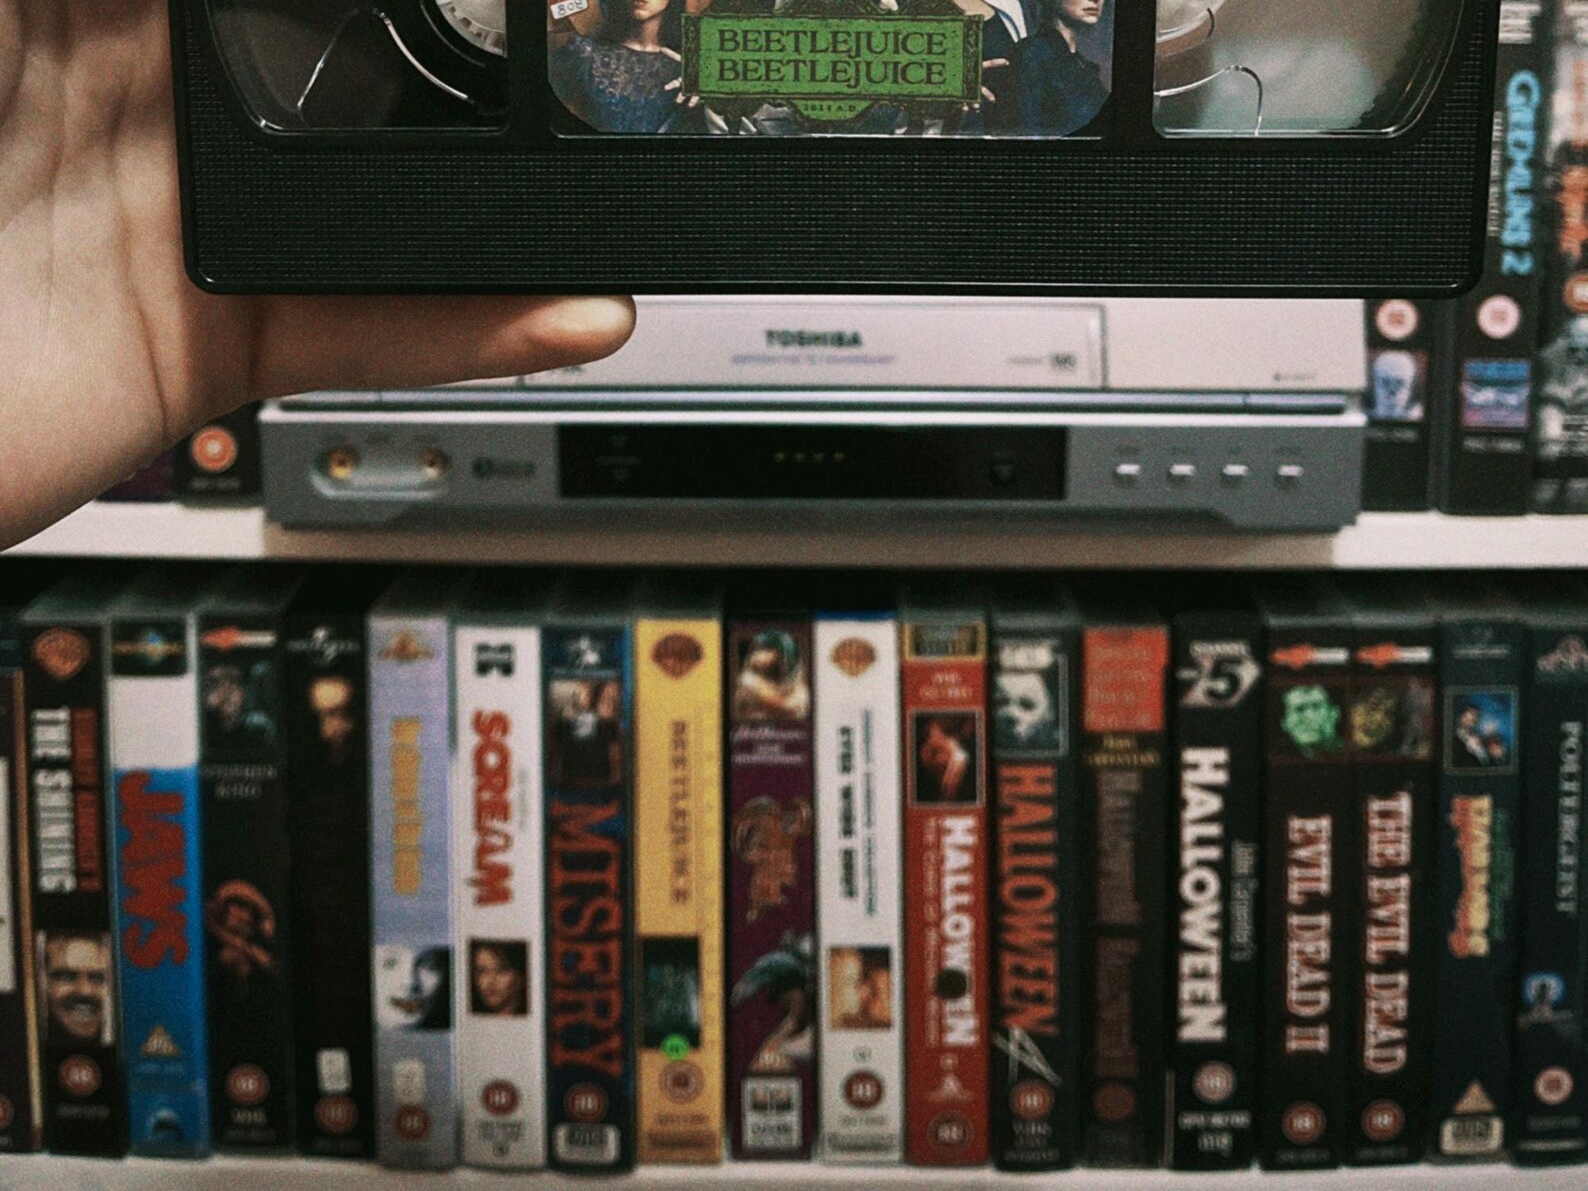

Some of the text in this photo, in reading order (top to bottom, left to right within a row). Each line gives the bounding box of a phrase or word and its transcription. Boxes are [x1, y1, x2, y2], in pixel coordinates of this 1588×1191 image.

[717, 29, 948, 59] BEETLEJUICE
[717, 59, 947, 89] BEETLEJUICE
[765, 329, 863, 347] TOSHIBA
[1501, 251, 1535, 276] 2
[32, 708, 77, 893] THE SHINING
[117, 771, 189, 969] JAWS
[468, 710, 514, 907] SCREAM
[1176, 747, 1230, 1043] HALLOWEEN
[550, 799, 622, 1077] MISERY
[939, 815, 980, 1046] HALLOWEN
[999, 764, 1058, 1037] HALLOWEEN
[1286, 815, 1333, 1054] EVIL DEAD II
[1363, 790, 1413, 1074] THE EVIL DEAD
